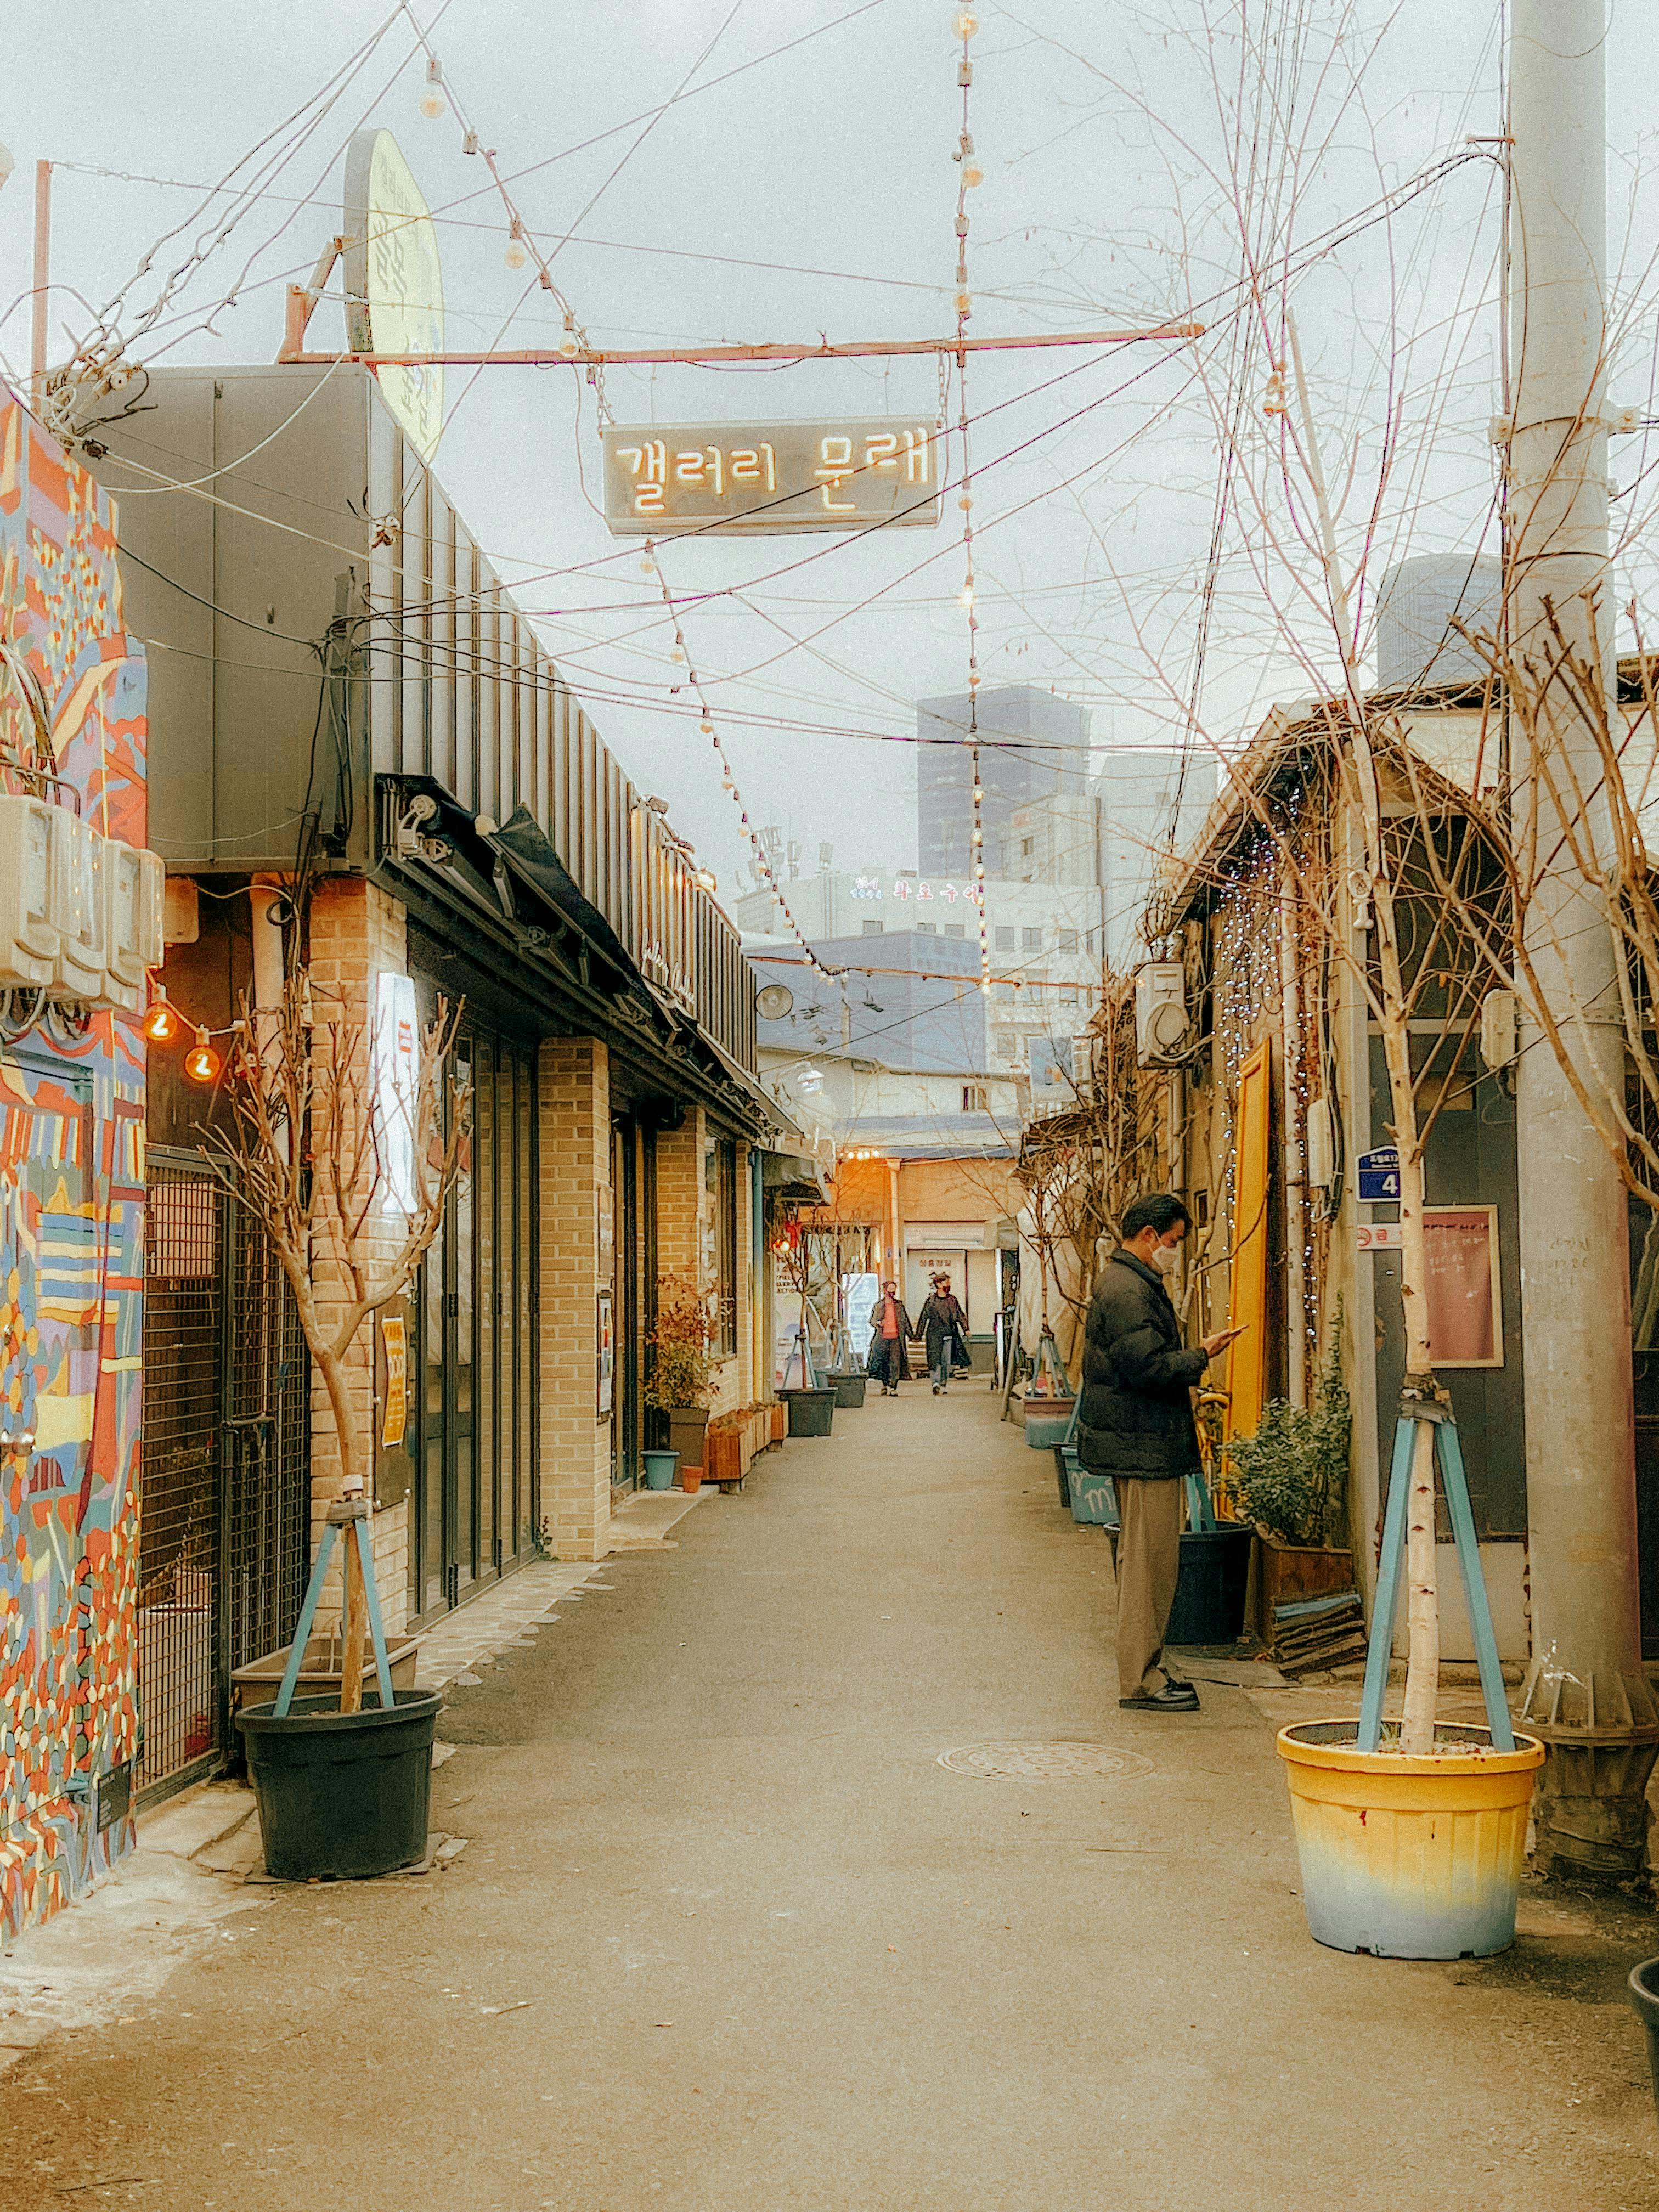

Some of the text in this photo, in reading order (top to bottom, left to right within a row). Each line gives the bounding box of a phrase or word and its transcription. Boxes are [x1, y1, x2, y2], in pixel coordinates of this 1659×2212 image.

[616, 426, 928, 512] 갤러리 문래
[893, 879, 977, 904] 화로구이
[1382, 1175, 1398, 1194] 4
